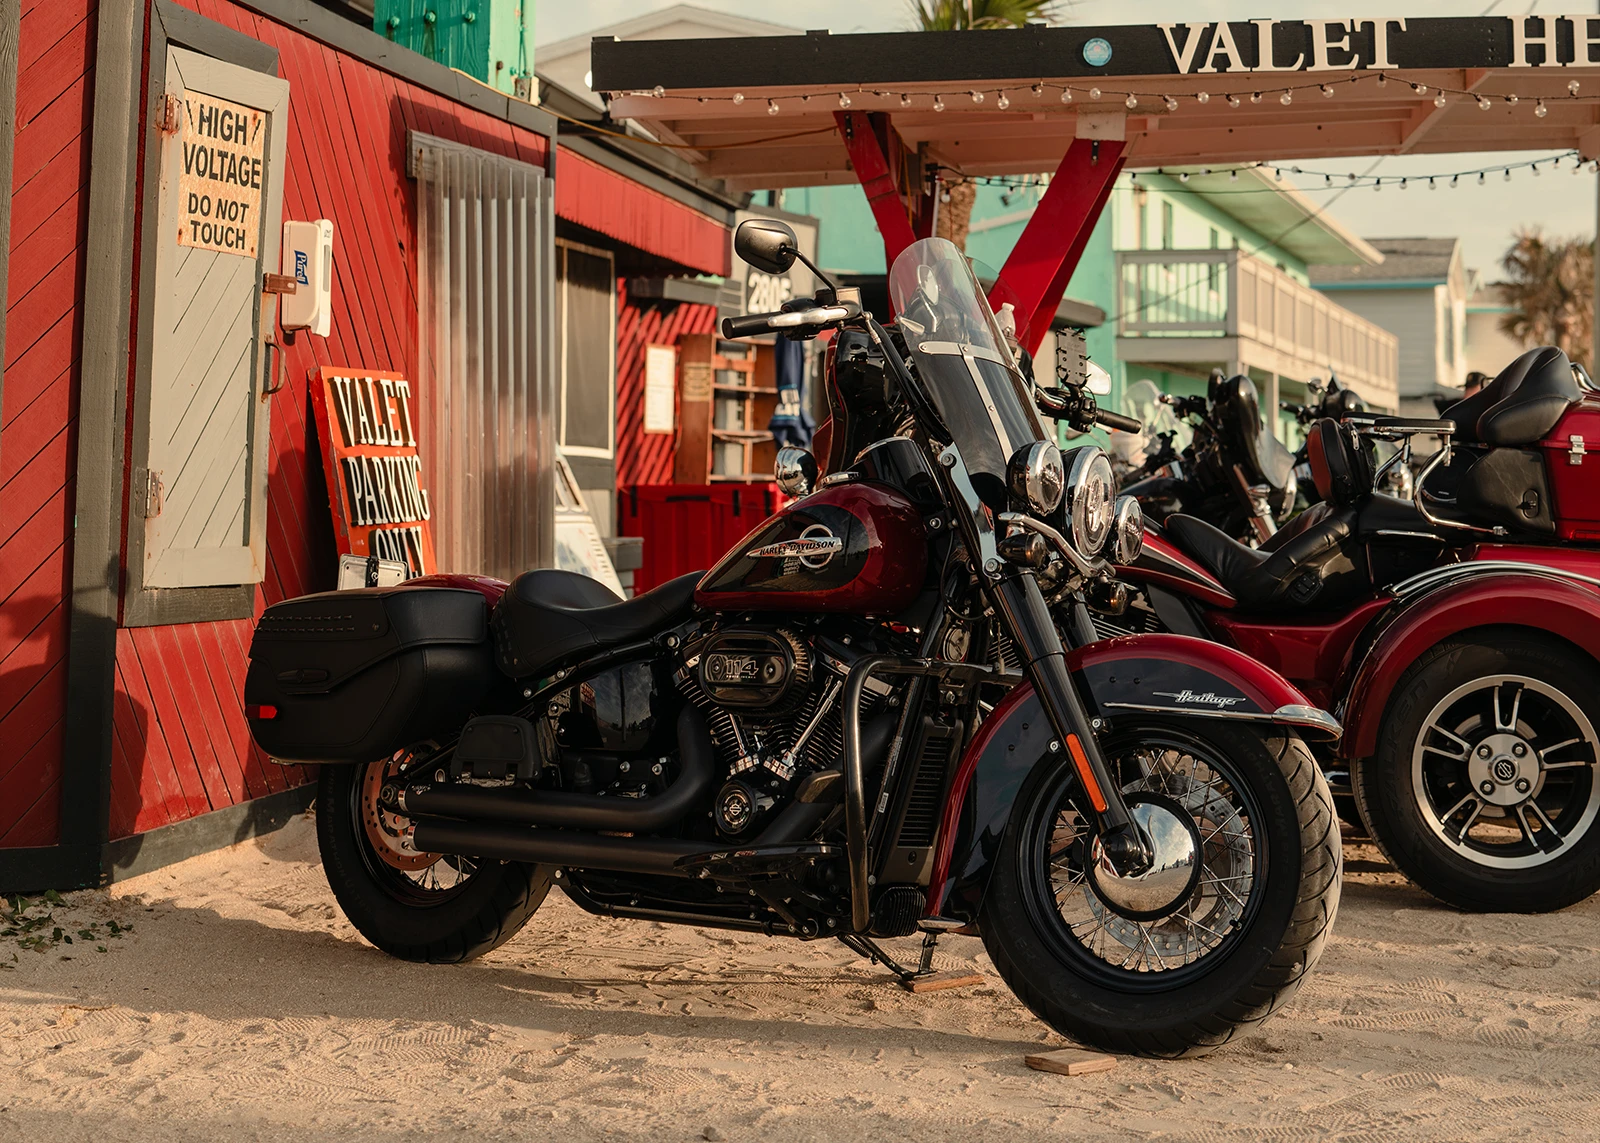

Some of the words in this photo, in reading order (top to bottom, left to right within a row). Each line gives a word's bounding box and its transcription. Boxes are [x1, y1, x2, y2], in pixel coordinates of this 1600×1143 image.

[1156, 17, 1408, 74] VALET
[198, 103, 247, 146] HIGH
[183, 141, 261, 190] VOLTAGE
[188, 192, 211, 217] DO
[215, 198, 249, 223] NOT
[190, 220, 246, 250] TOUCH
[331, 376, 416, 447] VALET
[343, 454, 430, 526] PARKING
[759, 540, 835, 556] HARLEY-DAVIDSON
[725, 659, 759, 676] 114
[1175, 689, 1237, 708] Heritage
